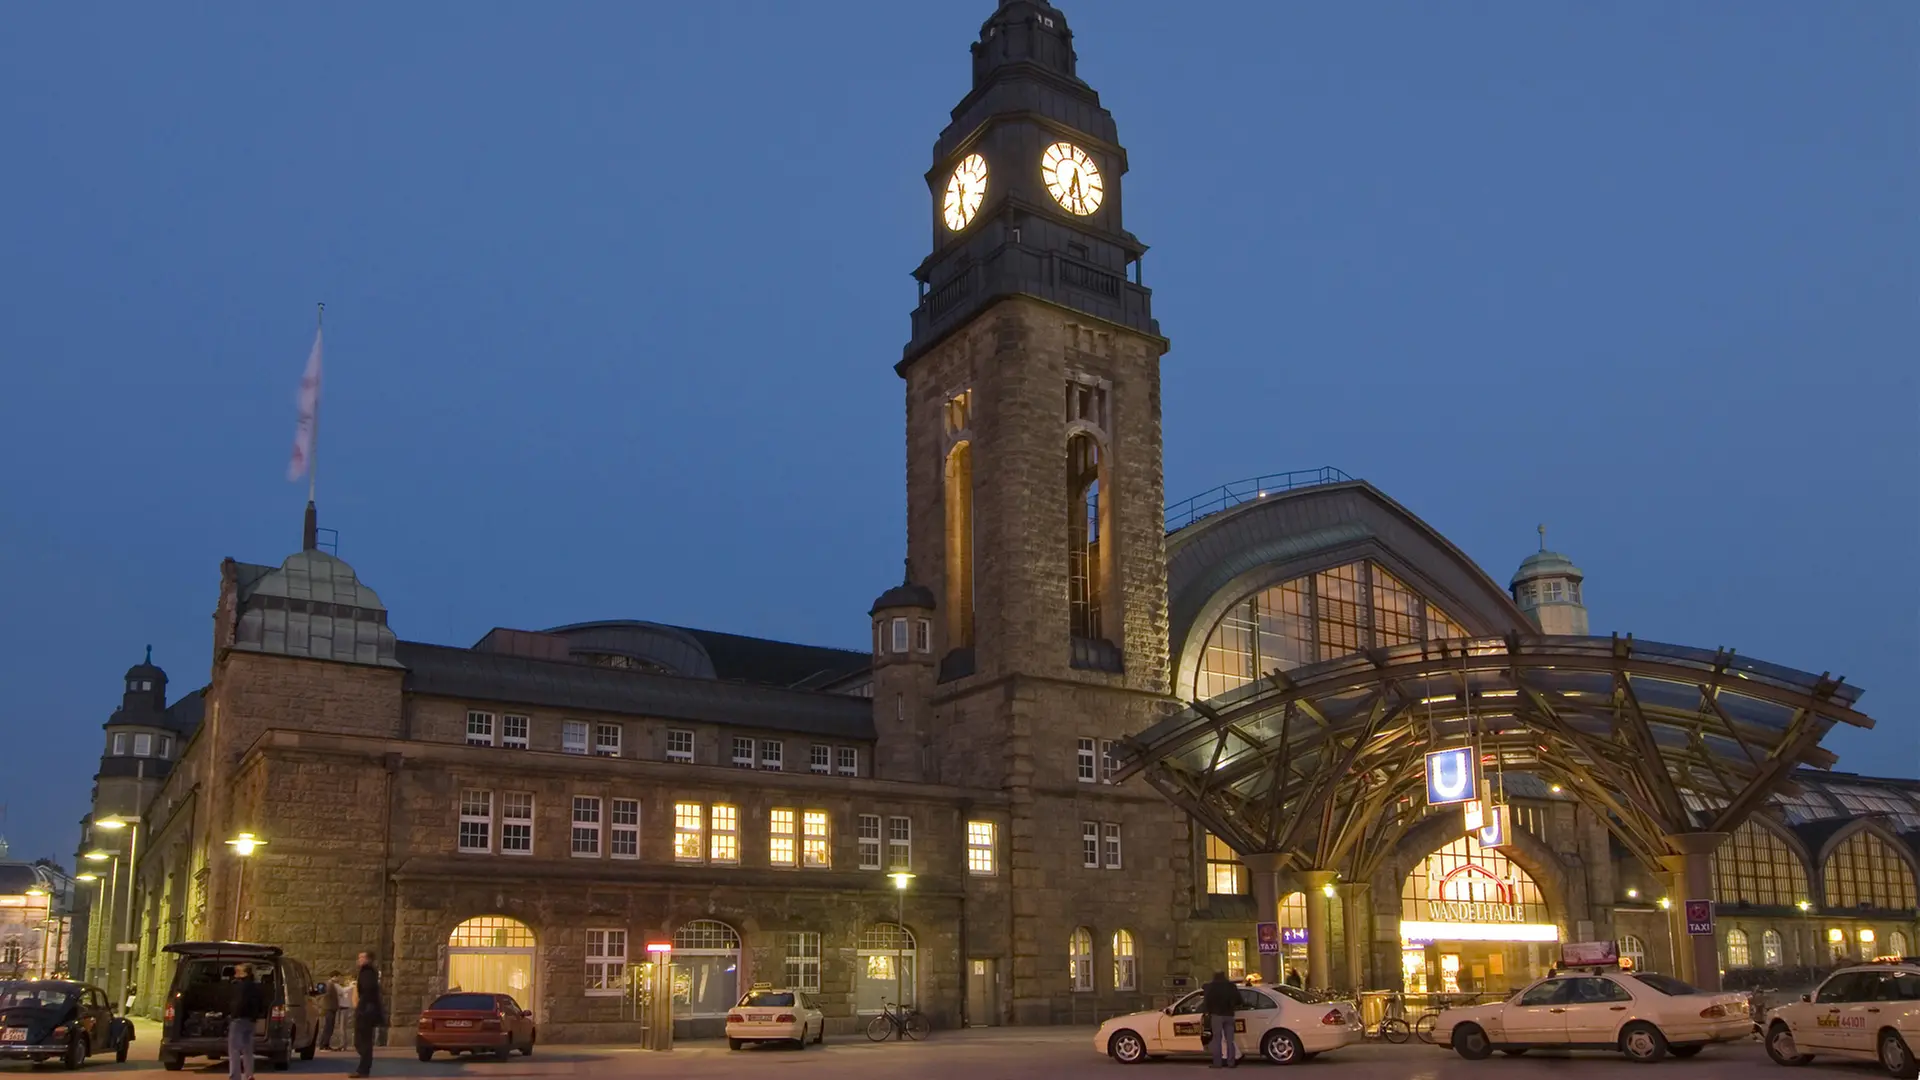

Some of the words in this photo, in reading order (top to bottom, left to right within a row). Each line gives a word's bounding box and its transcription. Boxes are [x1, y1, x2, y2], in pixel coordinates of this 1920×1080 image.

[1432, 753, 1467, 798] U
[1428, 901, 1524, 922] WANDELHALLE
[1690, 923, 1711, 932] TAXI
[1260, 943, 1278, 951] TAXI
